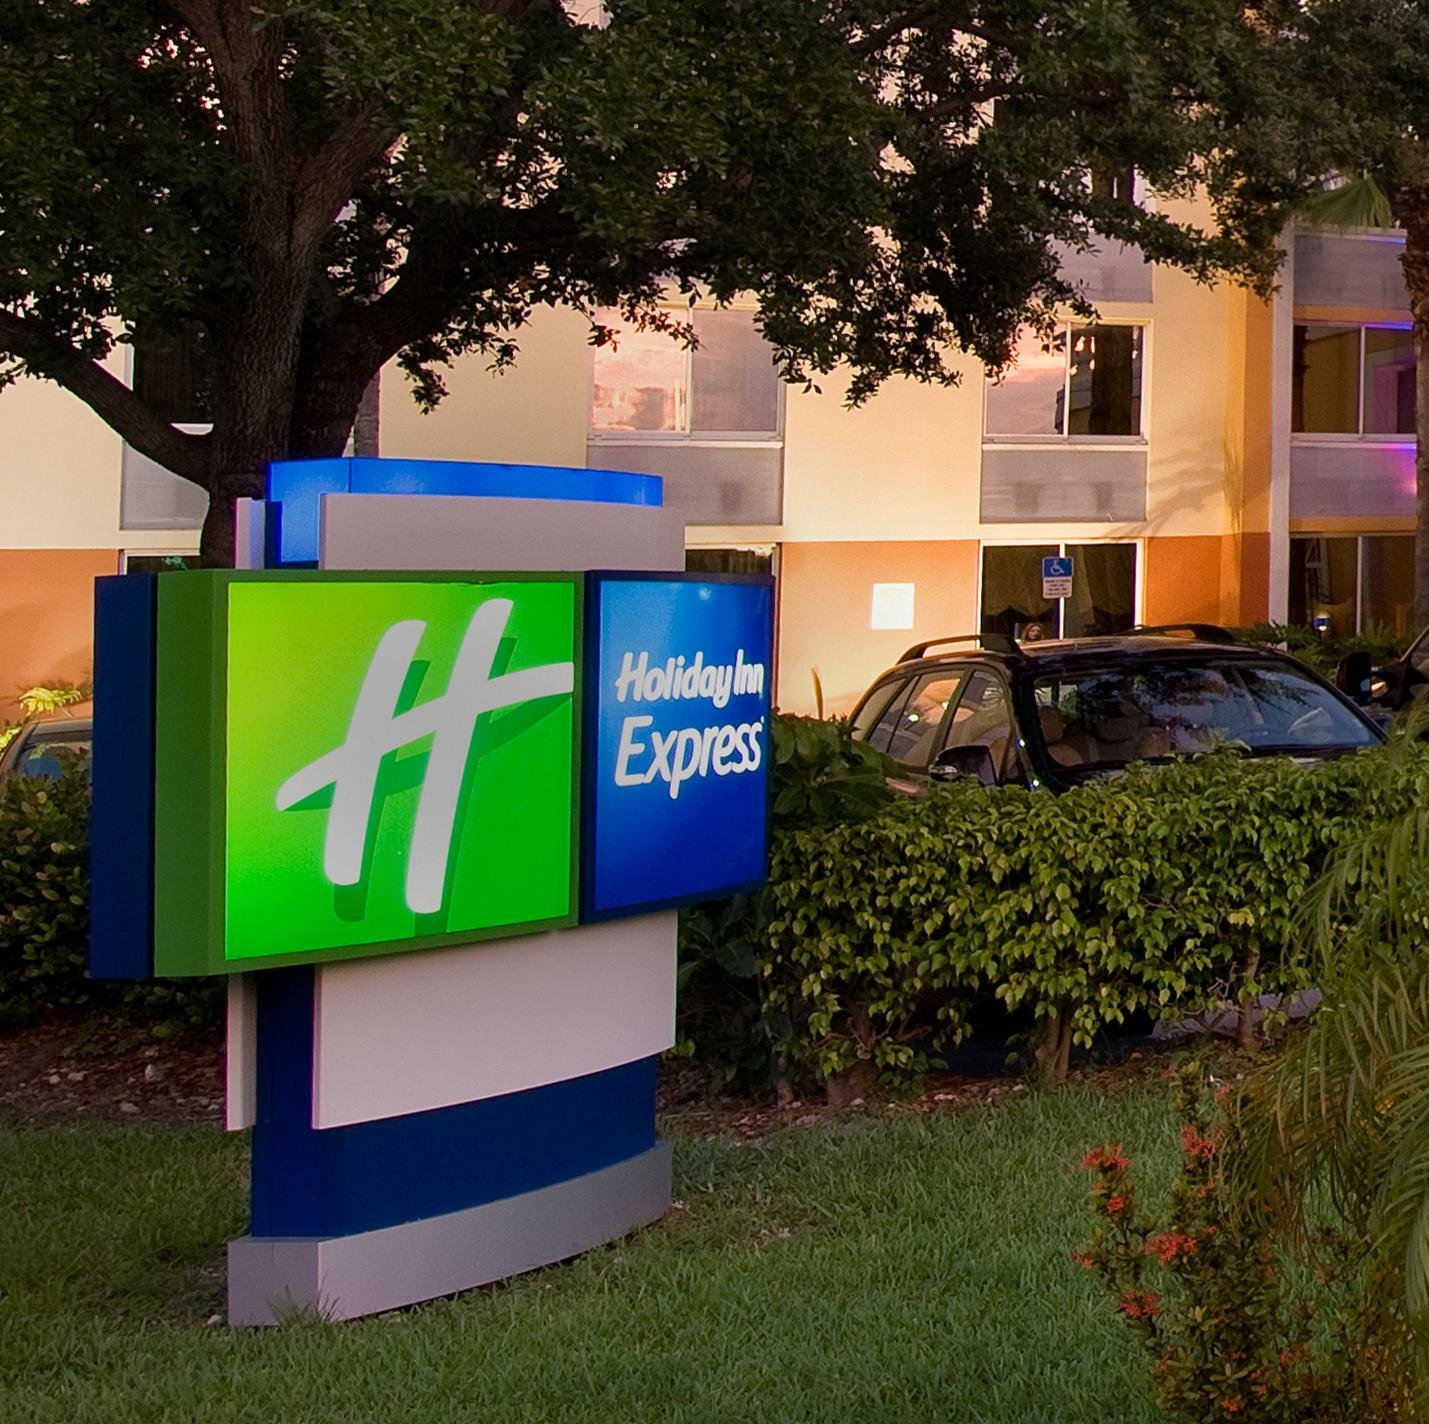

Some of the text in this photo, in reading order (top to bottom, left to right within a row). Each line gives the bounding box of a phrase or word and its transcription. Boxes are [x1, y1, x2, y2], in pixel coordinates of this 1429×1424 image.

[615, 648, 765, 709] Holiday Inn
[614, 715, 763, 800] Express
